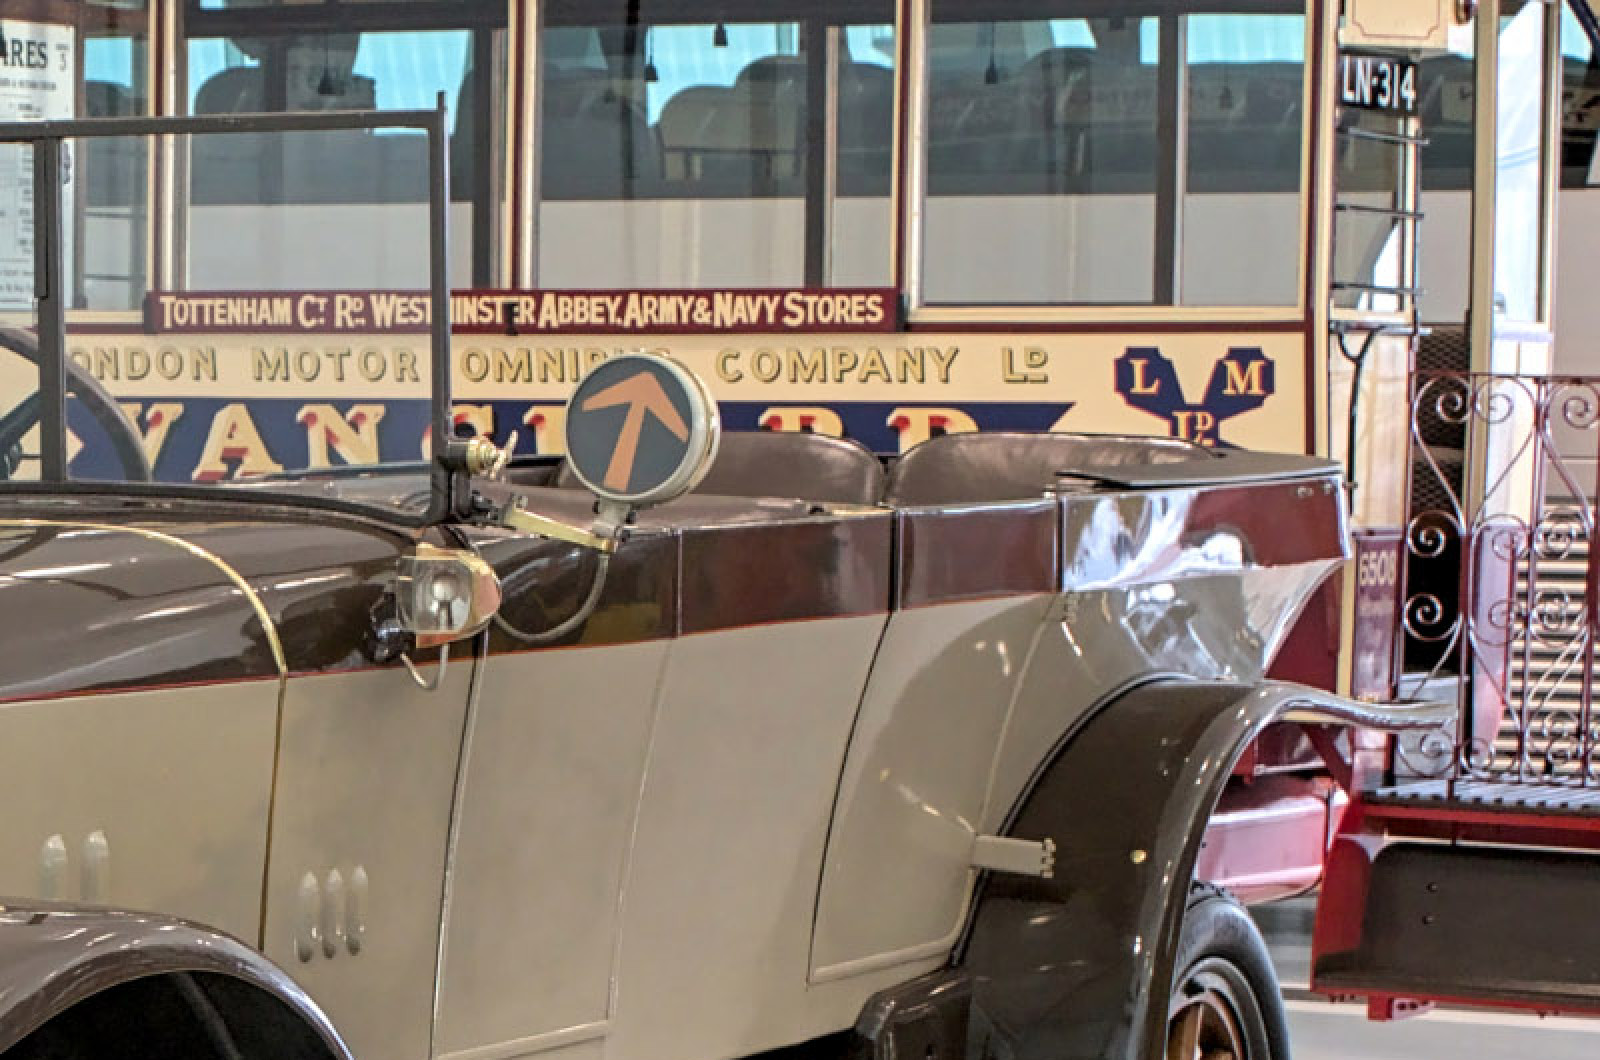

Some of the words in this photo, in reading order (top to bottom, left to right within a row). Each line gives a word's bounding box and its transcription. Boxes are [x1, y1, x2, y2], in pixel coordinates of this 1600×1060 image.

[159, 295, 292, 328] TOTTENHAM
[370, 293, 536, 326] WESTINSTER
[782, 291, 885, 326] STORES
[67, 347, 219, 382] ONDON
[252, 347, 421, 383] MOTOR
[715, 346, 960, 384] COMPANY
[1129, 359, 1161, 395] L
[1222, 359, 1269, 396] M
